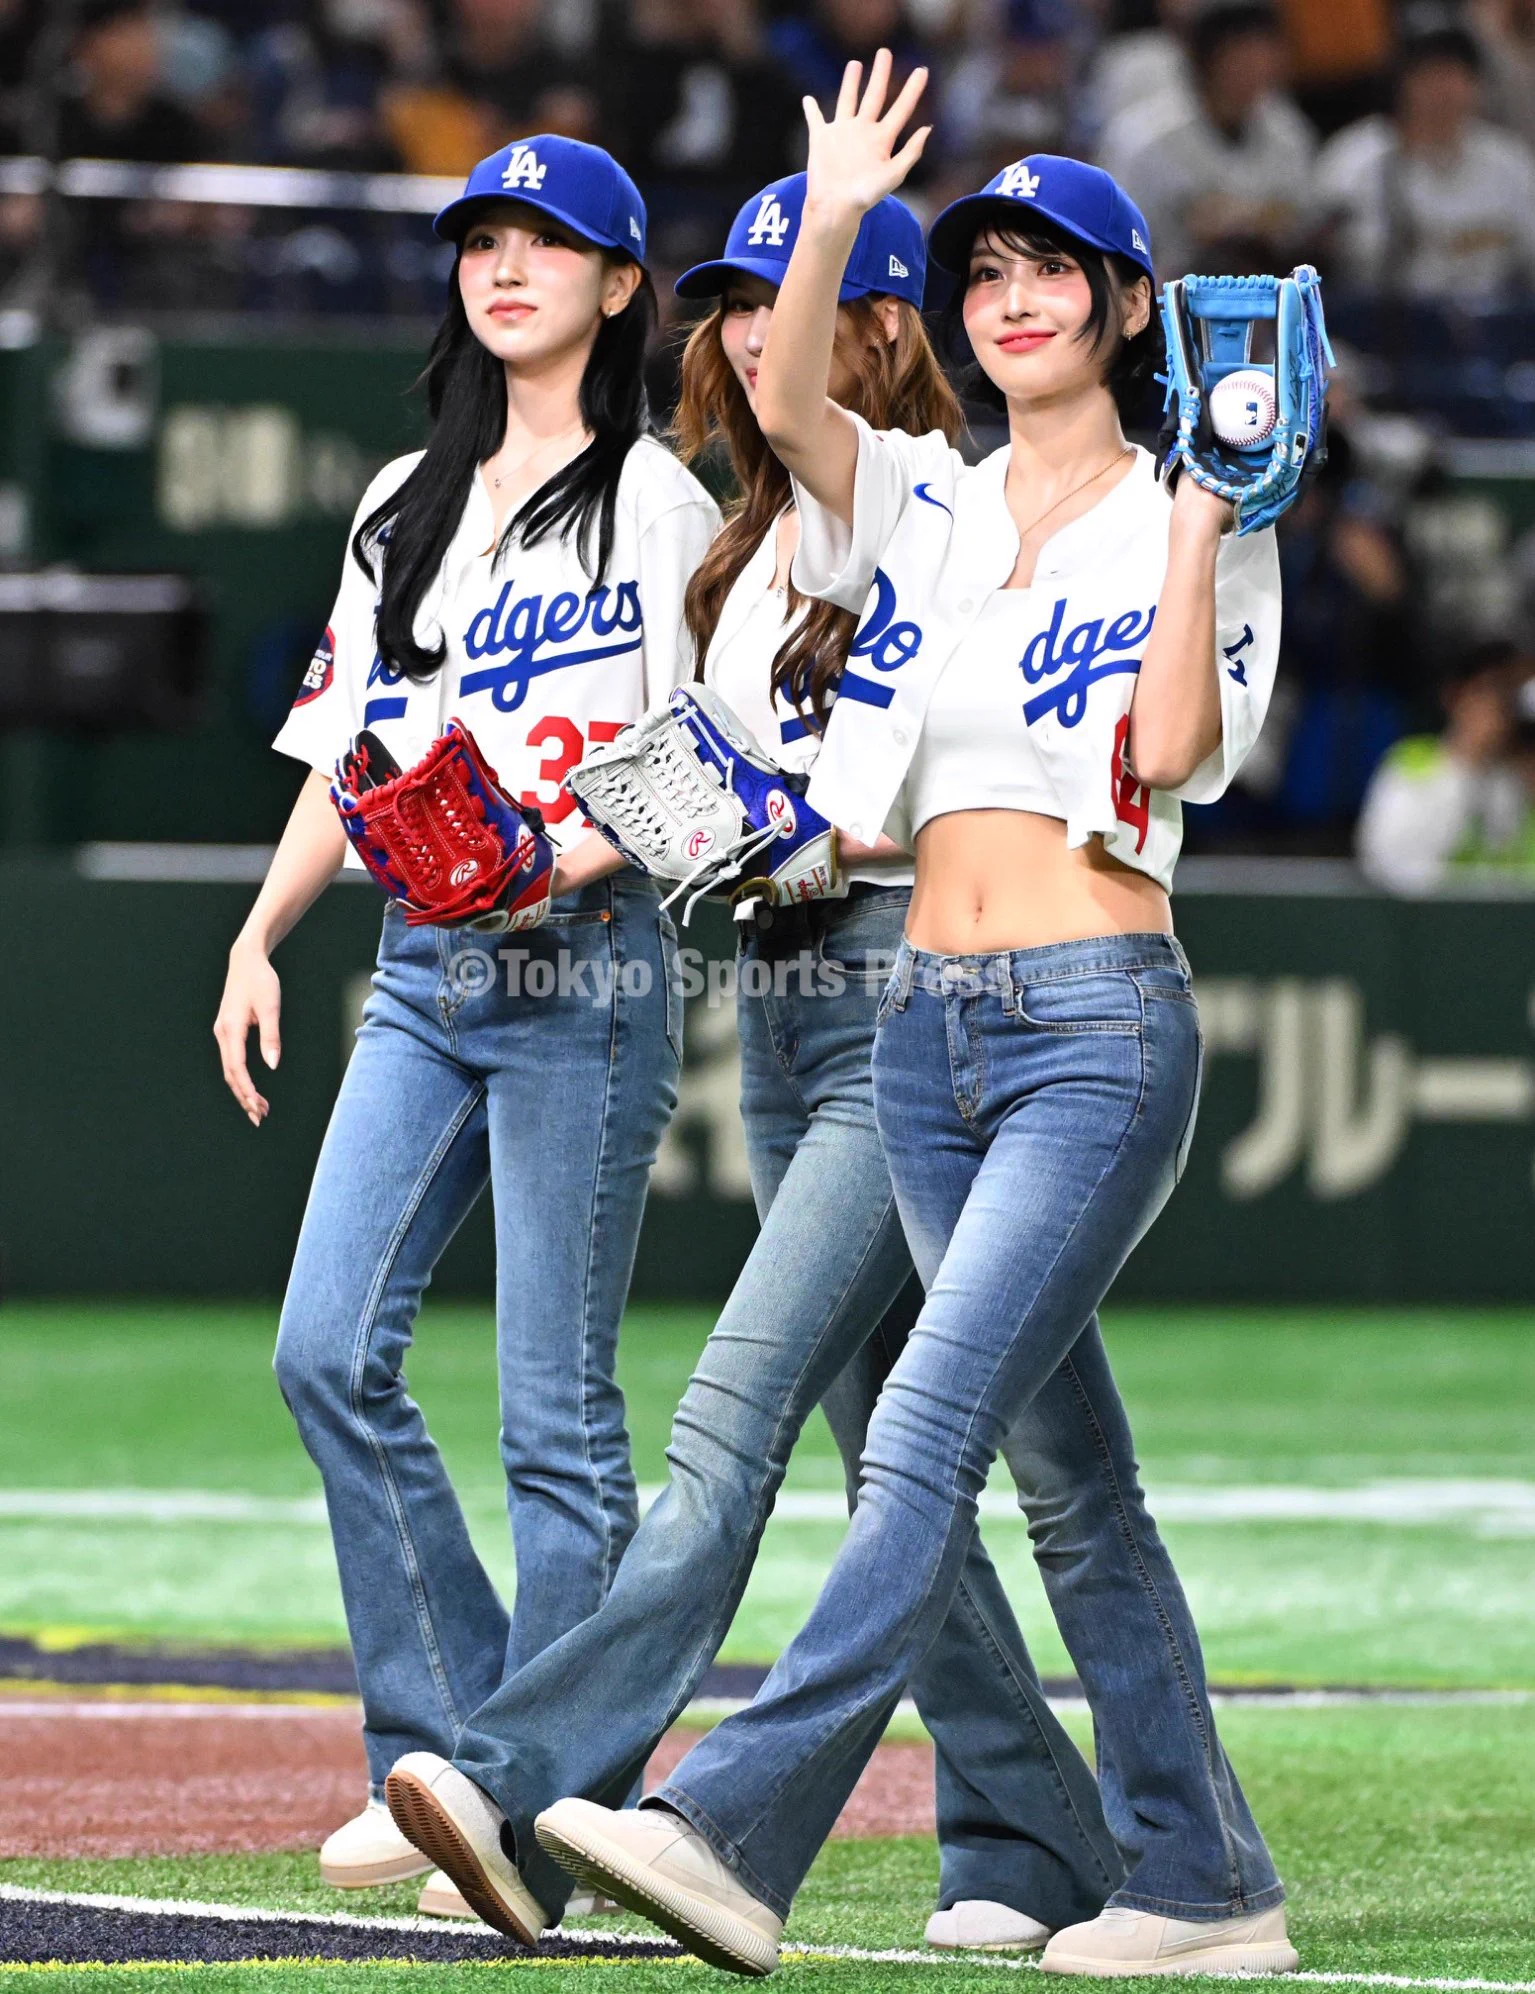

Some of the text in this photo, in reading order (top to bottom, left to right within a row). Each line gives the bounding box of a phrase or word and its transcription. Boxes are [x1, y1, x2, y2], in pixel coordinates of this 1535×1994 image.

[501, 145, 548, 190] LA
[994, 162, 1040, 198] LA
[747, 194, 790, 247] LA
[366, 578, 643, 713] dgers
